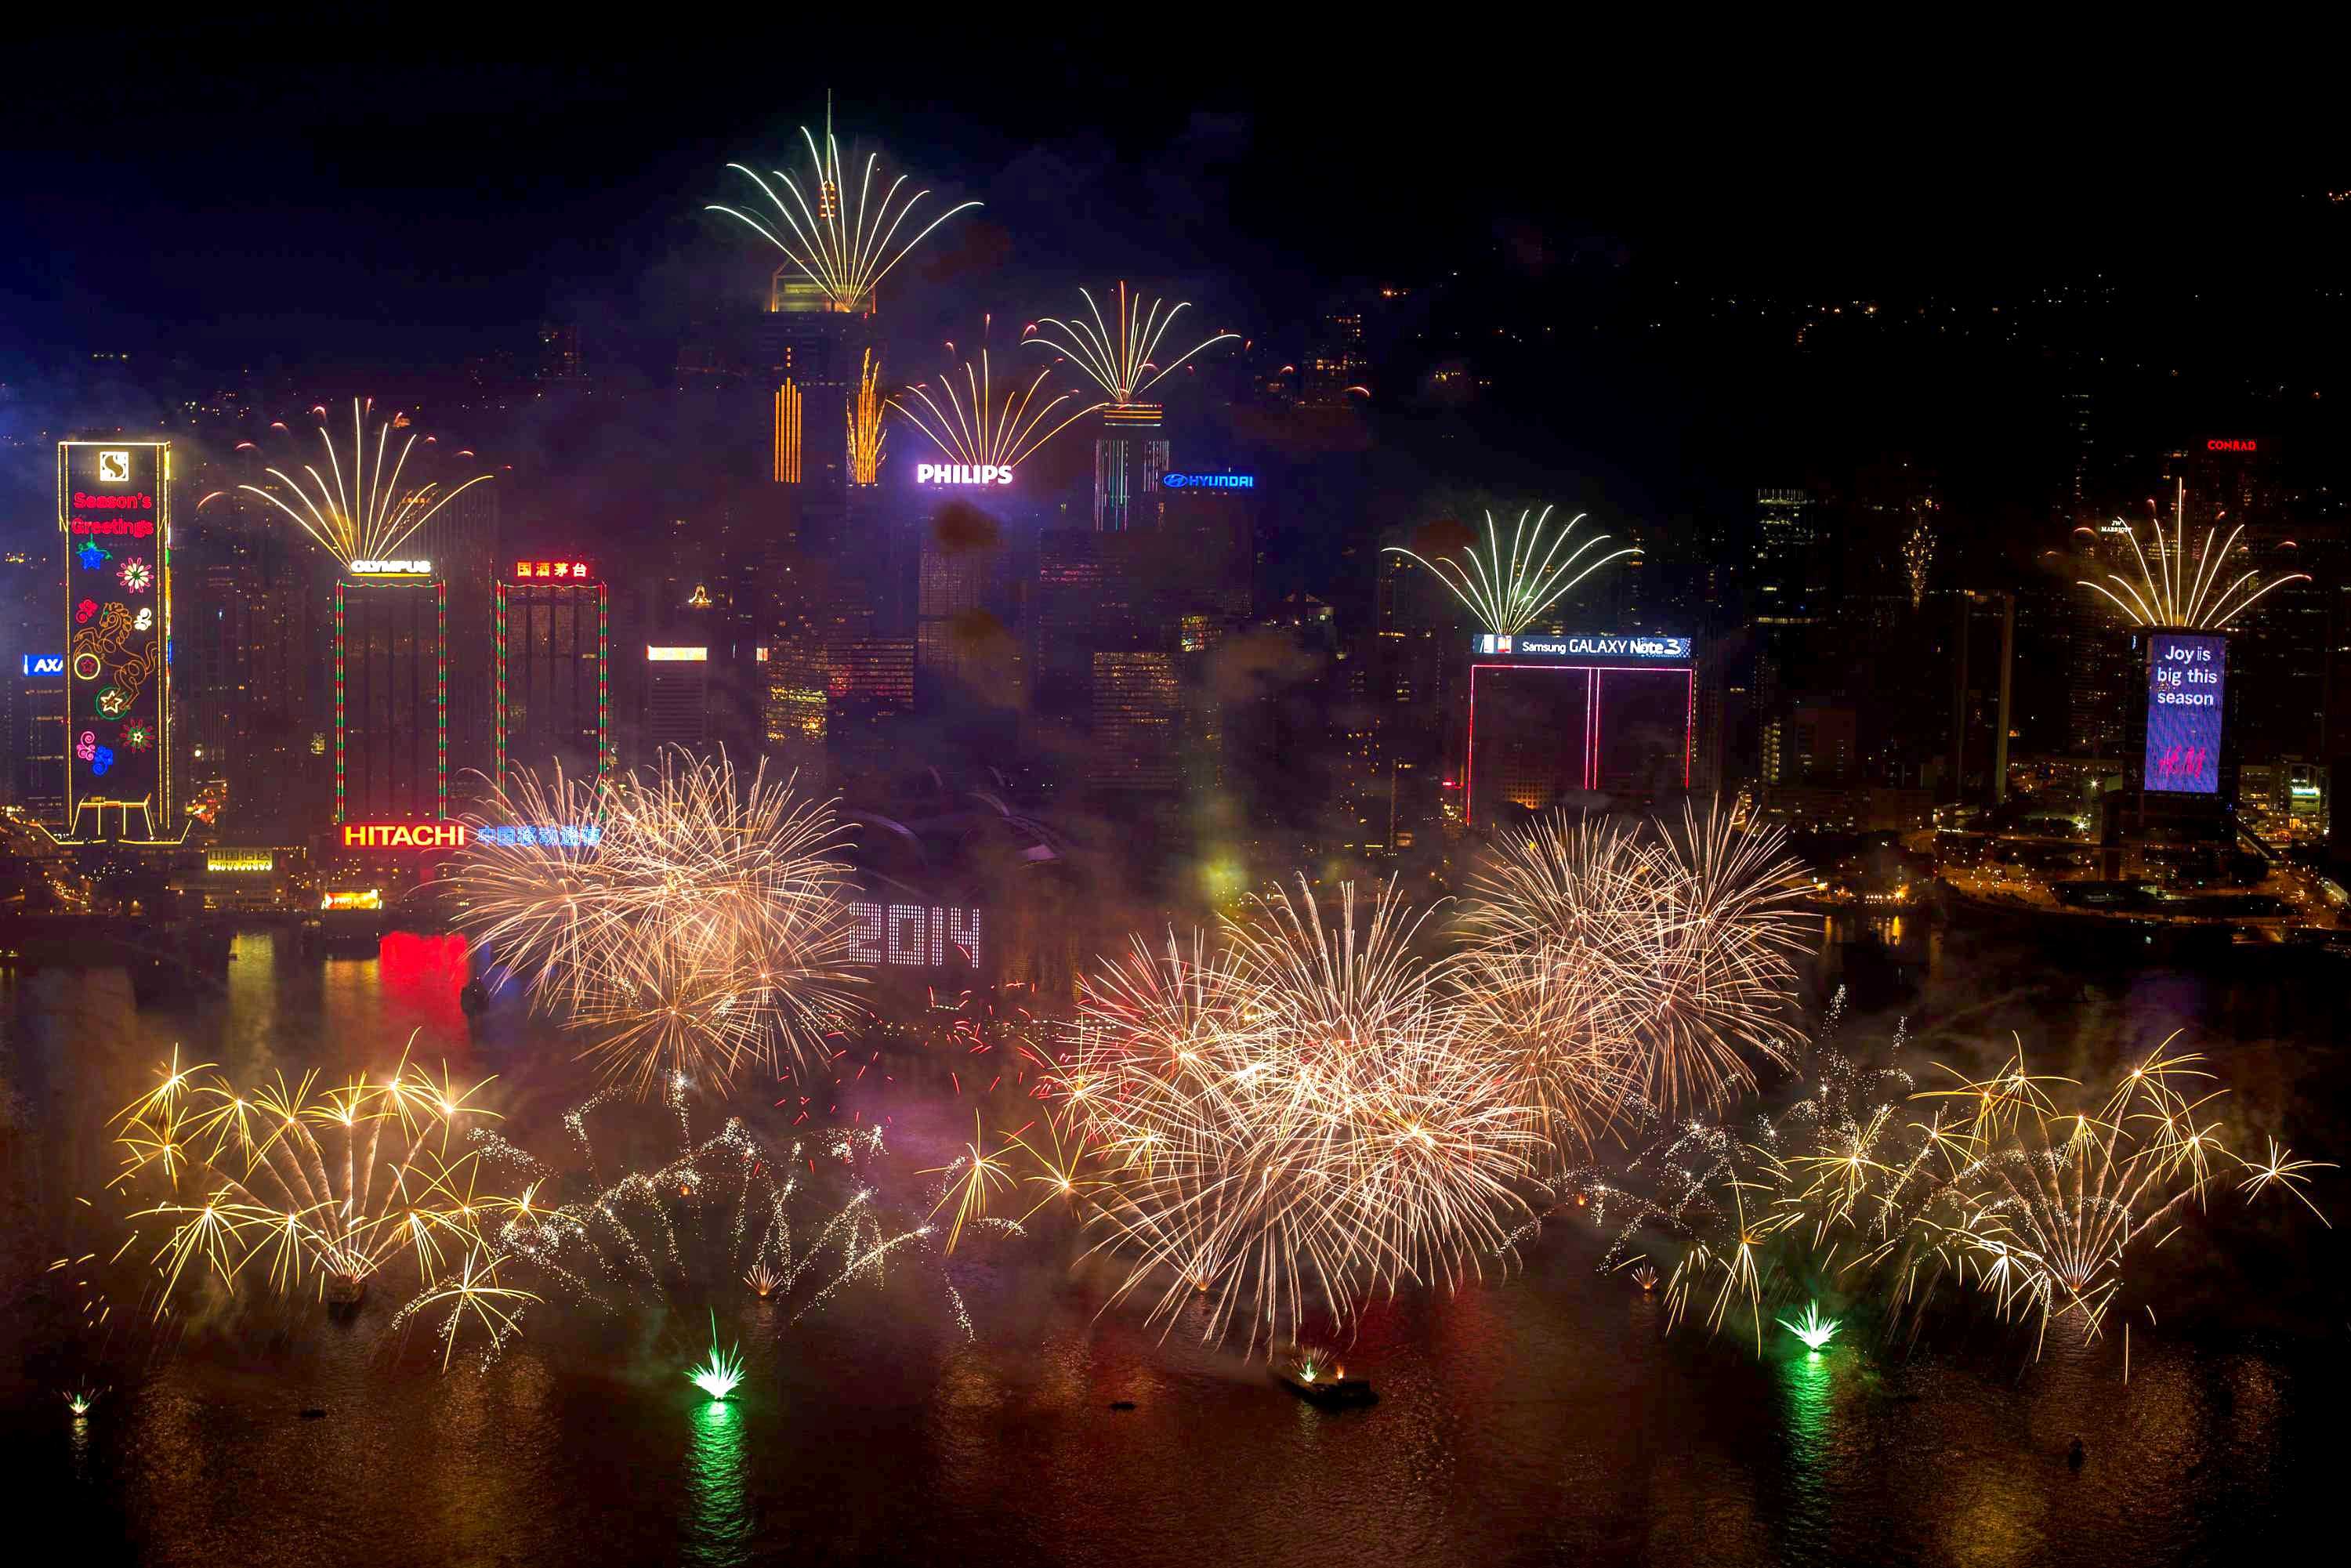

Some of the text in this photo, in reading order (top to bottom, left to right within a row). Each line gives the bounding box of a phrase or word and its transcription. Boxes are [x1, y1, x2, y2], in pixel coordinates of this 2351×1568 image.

[2208, 440, 2256, 451] CONRAD
[916, 464, 1012, 484] PHILIPS
[1189, 476, 1253, 487] HYUNDAI
[74, 492, 152, 509] Season's
[71, 517, 154, 538] Greetings
[351, 560, 431, 573] OLYMPUS
[517, 562, 587, 577] 国酒茅台
[1522, 641, 1566, 655] Samsung
[1569, 639, 1627, 654] GALAXY
[2165, 646, 2194, 664] Joy
[2157, 667, 2218, 686] big this
[2157, 693, 2214, 705] season
[345, 825, 465, 846] HITACHI
[477, 824, 601, 847] 中国移动通信
[849, 902, 979, 969] 2014
